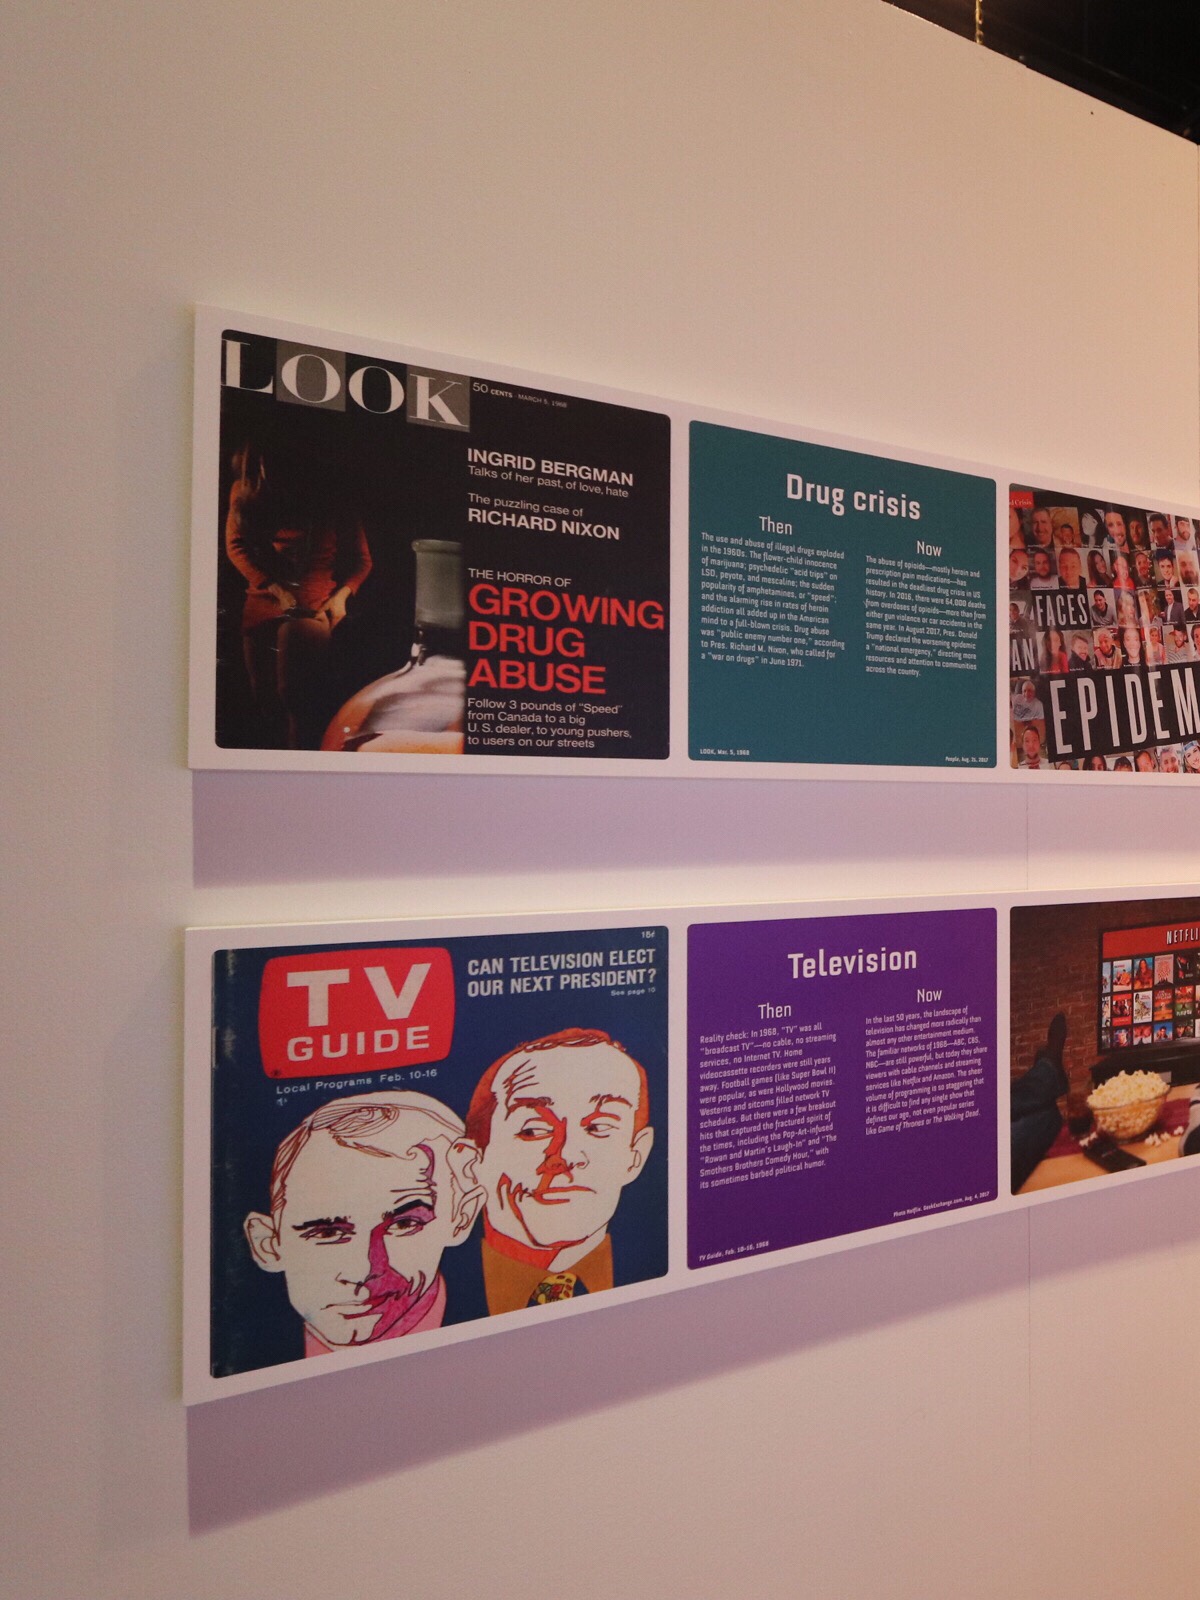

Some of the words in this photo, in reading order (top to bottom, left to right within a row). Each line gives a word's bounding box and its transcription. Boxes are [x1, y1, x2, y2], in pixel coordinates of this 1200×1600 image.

[221, 339, 470, 428] LOOK
[472, 381, 489, 394] 50
[490, 388, 513, 399] CENTS
[517, 393, 542, 403] MARCH
[467, 447, 536, 471] INGRID
[541, 459, 633, 487] BERGMAN
[467, 464, 498, 479] Talks
[515, 472, 535, 484] her
[537, 477, 564, 489] past,
[579, 481, 604, 495] love,
[605, 485, 629, 498] hate
[467, 492, 491, 505] The
[493, 498, 540, 514] puzzling
[542, 505, 570, 516] case
[786, 473, 845, 517] Drug
[853, 489, 921, 520] crisis
[468, 507, 557, 532] RICHARD
[561, 520, 620, 541] NIXON
[758, 515, 793, 536] Then
[701, 531, 714, 542] The
[744, 538, 765, 549] abuse
[766, 541, 774, 552] of
[774, 542, 796, 555] illegal
[796, 545, 815, 558] drugs
[816, 549, 845, 560] exploded
[916, 540, 942, 557] Now
[467, 567, 494, 580] THE
[497, 570, 552, 586] HORROR
[554, 577, 572, 588] OF
[701, 555, 709, 567] of
[710, 558, 747, 571] marijuana;
[748, 563, 789, 575] psychedelic
[804, 559, 838, 570] innocence
[469, 583, 665, 629] GROWING
[1036, 592, 1089, 628] FACES
[469, 620, 586, 658] DRUG
[1011, 637, 1036, 673] AN
[468, 658, 606, 695] ABUSE
[467, 697, 506, 709] Follow
[508, 699, 517, 710] 3
[520, 701, 563, 712] pounds
[467, 710, 495, 721] from
[497, 711, 542, 723] Canada
[568, 714, 586, 727] big
[495, 723, 534, 735] dealer,
[550, 727, 585, 738] young
[587, 727, 632, 739] pushers,
[557, 738, 595, 749] streets
[467, 957, 503, 976] CAN
[509, 951, 603, 973] TELEVISION
[609, 948, 656, 966] ELECT
[787, 946, 917, 979] Television
[286, 962, 432, 1027] TV
[467, 979, 504, 998] OUR
[510, 975, 554, 994] NEXT
[559, 968, 657, 990] PRESIDENT?
[917, 988, 943, 1003] Now
[757, 1002, 792, 1020] Then
[287, 1025, 430, 1062] GUIDE
[700, 1033, 725, 1044] Reality
[725, 1030, 749, 1041] check:
[805, 1033, 837, 1044] streaming
[276, 1083, 310, 1095] Local
[315, 1077, 372, 1090] Programs
[409, 1068, 438, 1079] 10-16
